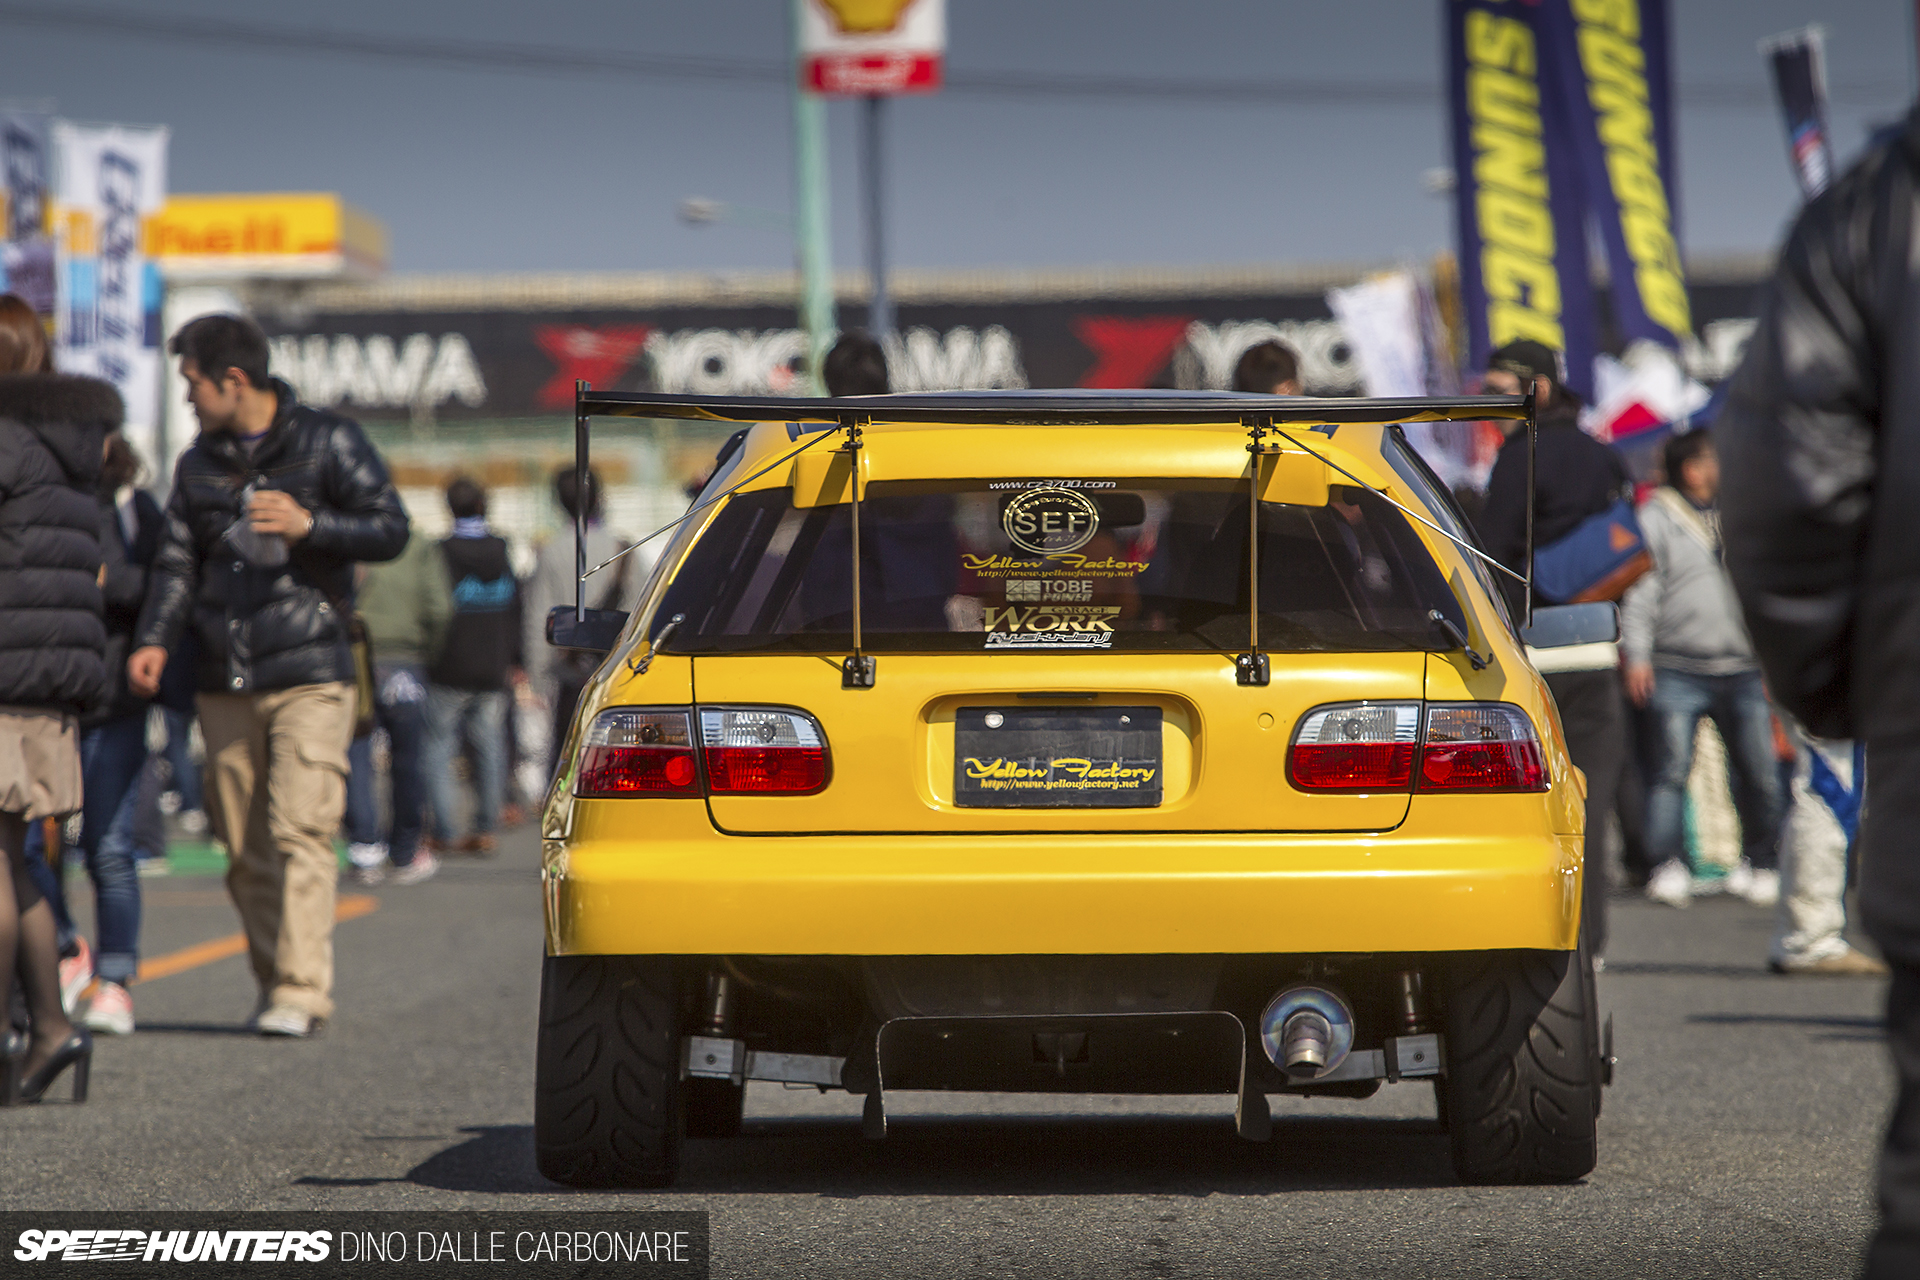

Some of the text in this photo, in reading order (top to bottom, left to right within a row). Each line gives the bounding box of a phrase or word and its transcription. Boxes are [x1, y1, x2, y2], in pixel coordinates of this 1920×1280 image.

[1015, 511, 1090, 534] SEF
[962, 553, 1150, 573] Yellow Factory
[1042, 580, 1093, 593] TOBE
[1043, 593, 1092, 602] POWER
[983, 606, 1119, 632] WORK
[964, 758, 1155, 782] Yellow Factory
